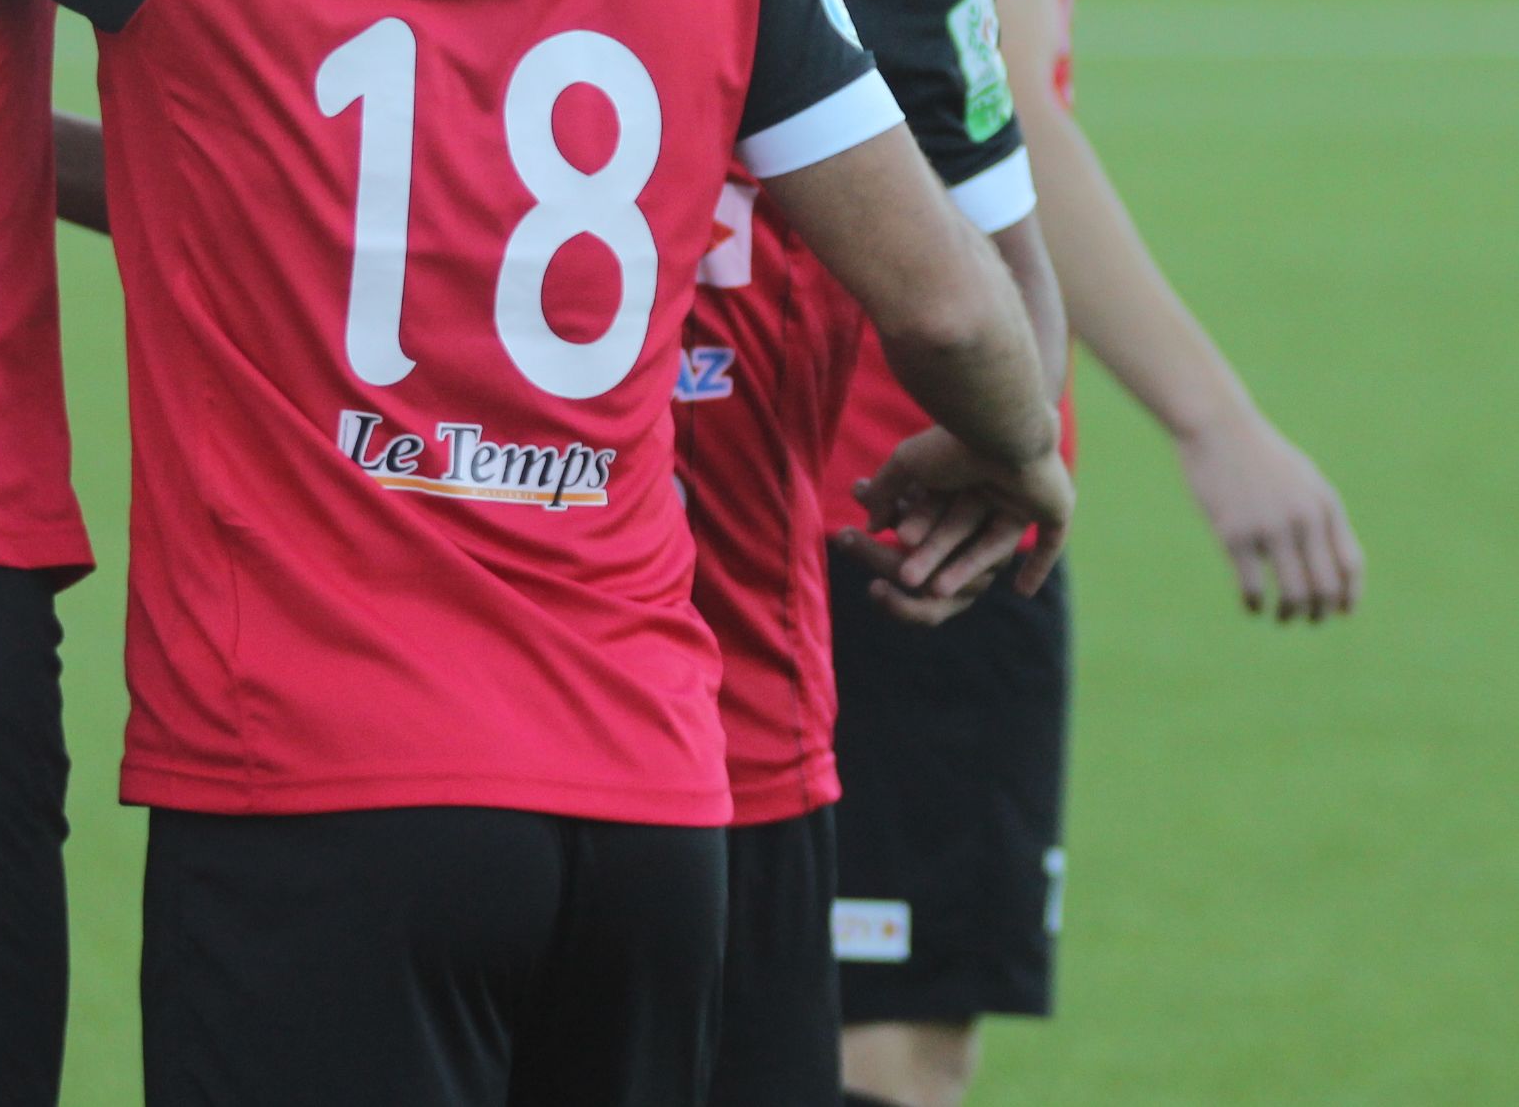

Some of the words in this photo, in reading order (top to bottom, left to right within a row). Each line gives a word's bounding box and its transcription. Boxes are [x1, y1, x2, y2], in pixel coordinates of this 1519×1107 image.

[315, 16, 663, 400] 18
[349, 413, 423, 473] Le
[439, 425, 615, 508] Temps
